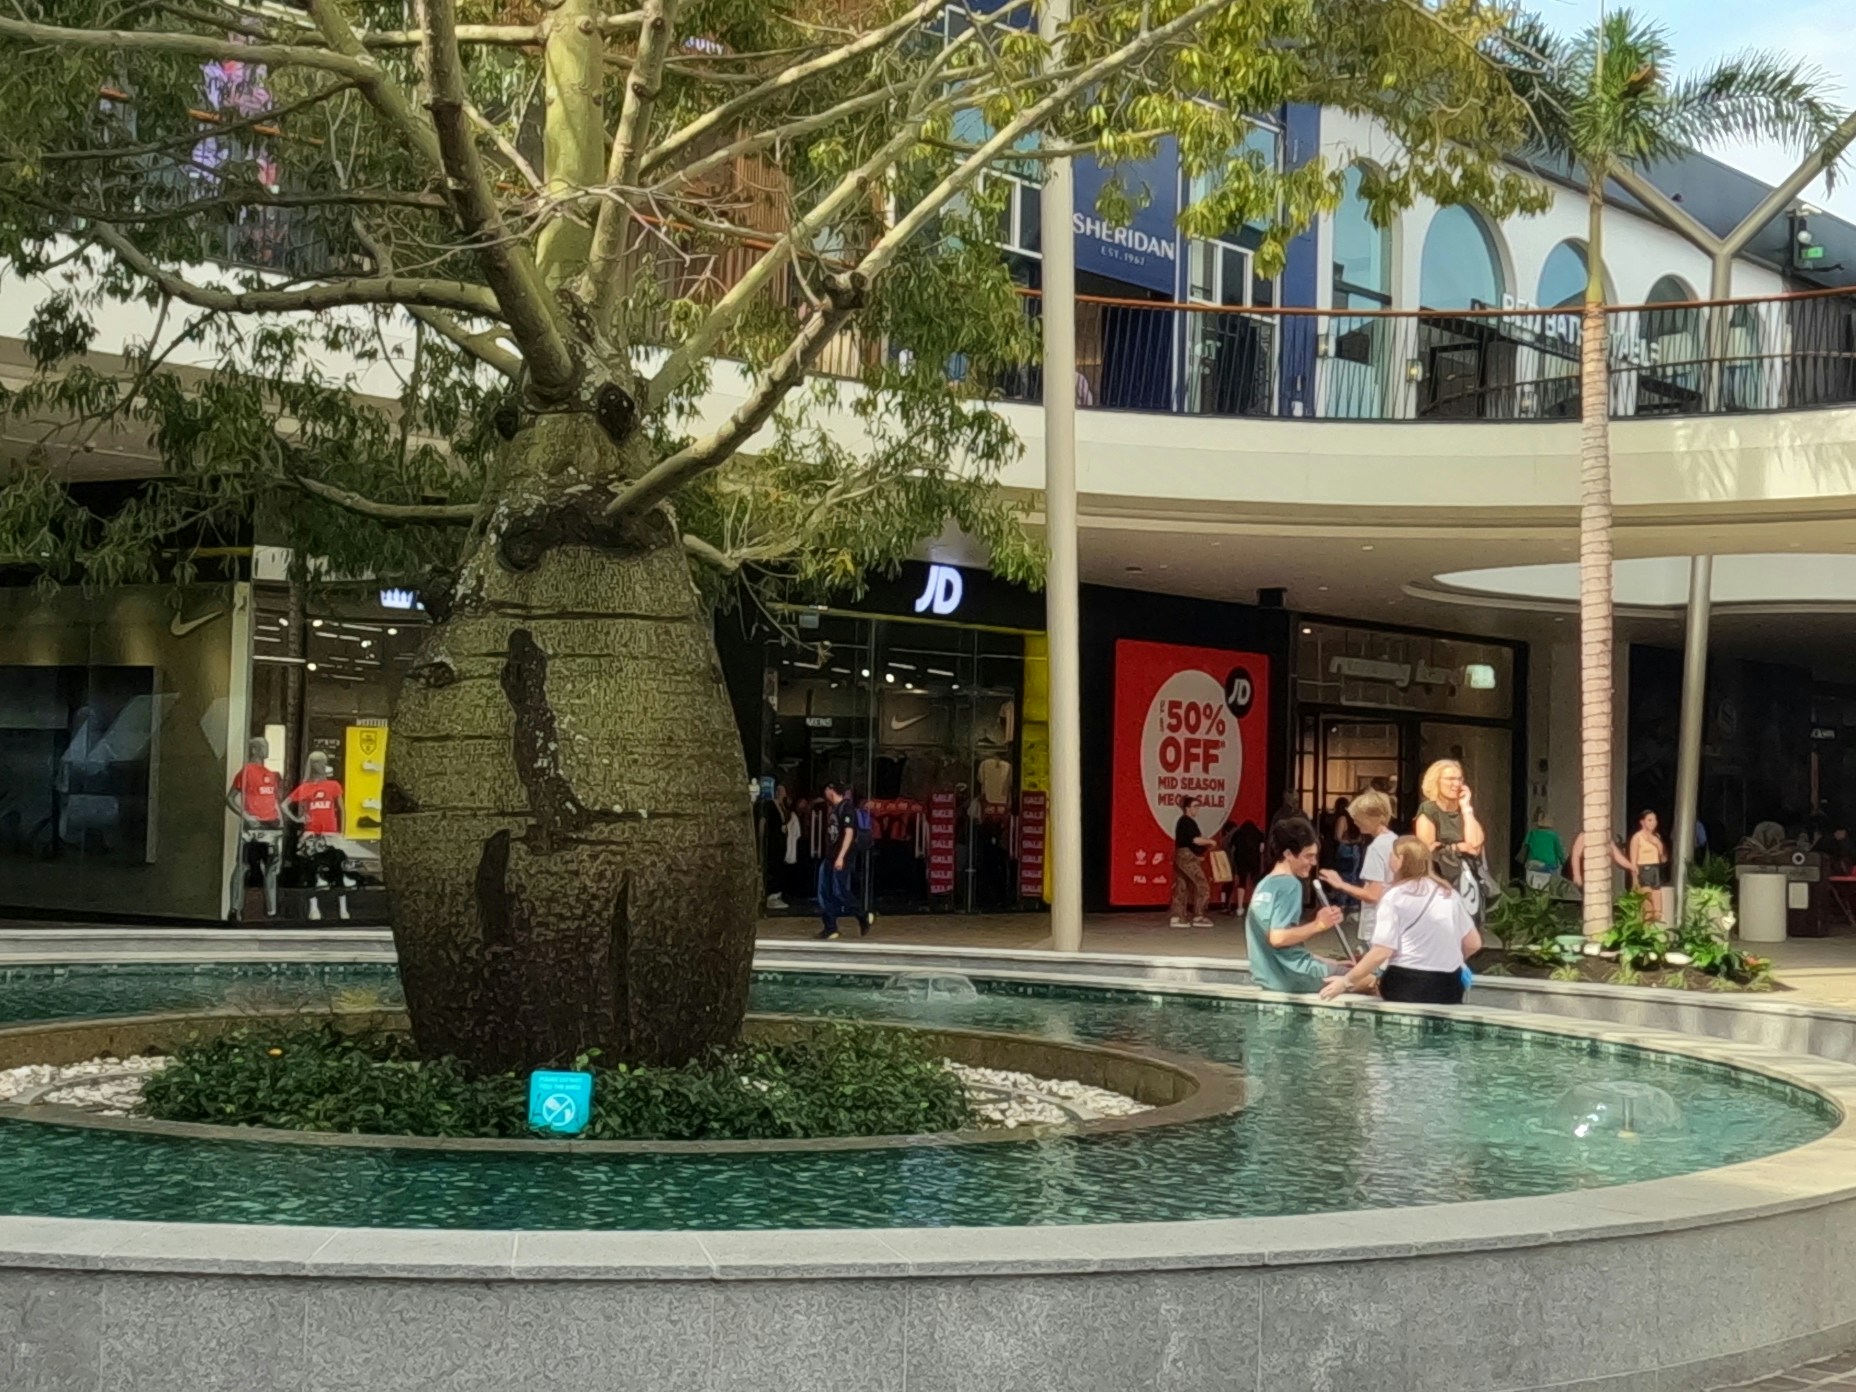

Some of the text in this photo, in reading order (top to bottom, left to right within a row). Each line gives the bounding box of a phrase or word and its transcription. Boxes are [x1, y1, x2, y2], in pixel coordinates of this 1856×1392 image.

[1073, 213, 1175, 261] SHERIDAN
[915, 565, 963, 615] JD
[1228, 679, 1251, 705] JD
[806, 717, 832, 728] MENS
[1166, 700, 1226, 736] 50%
[1158, 776, 1225, 791] MID SEASON
[1158, 793, 1225, 808] MEG SALE
